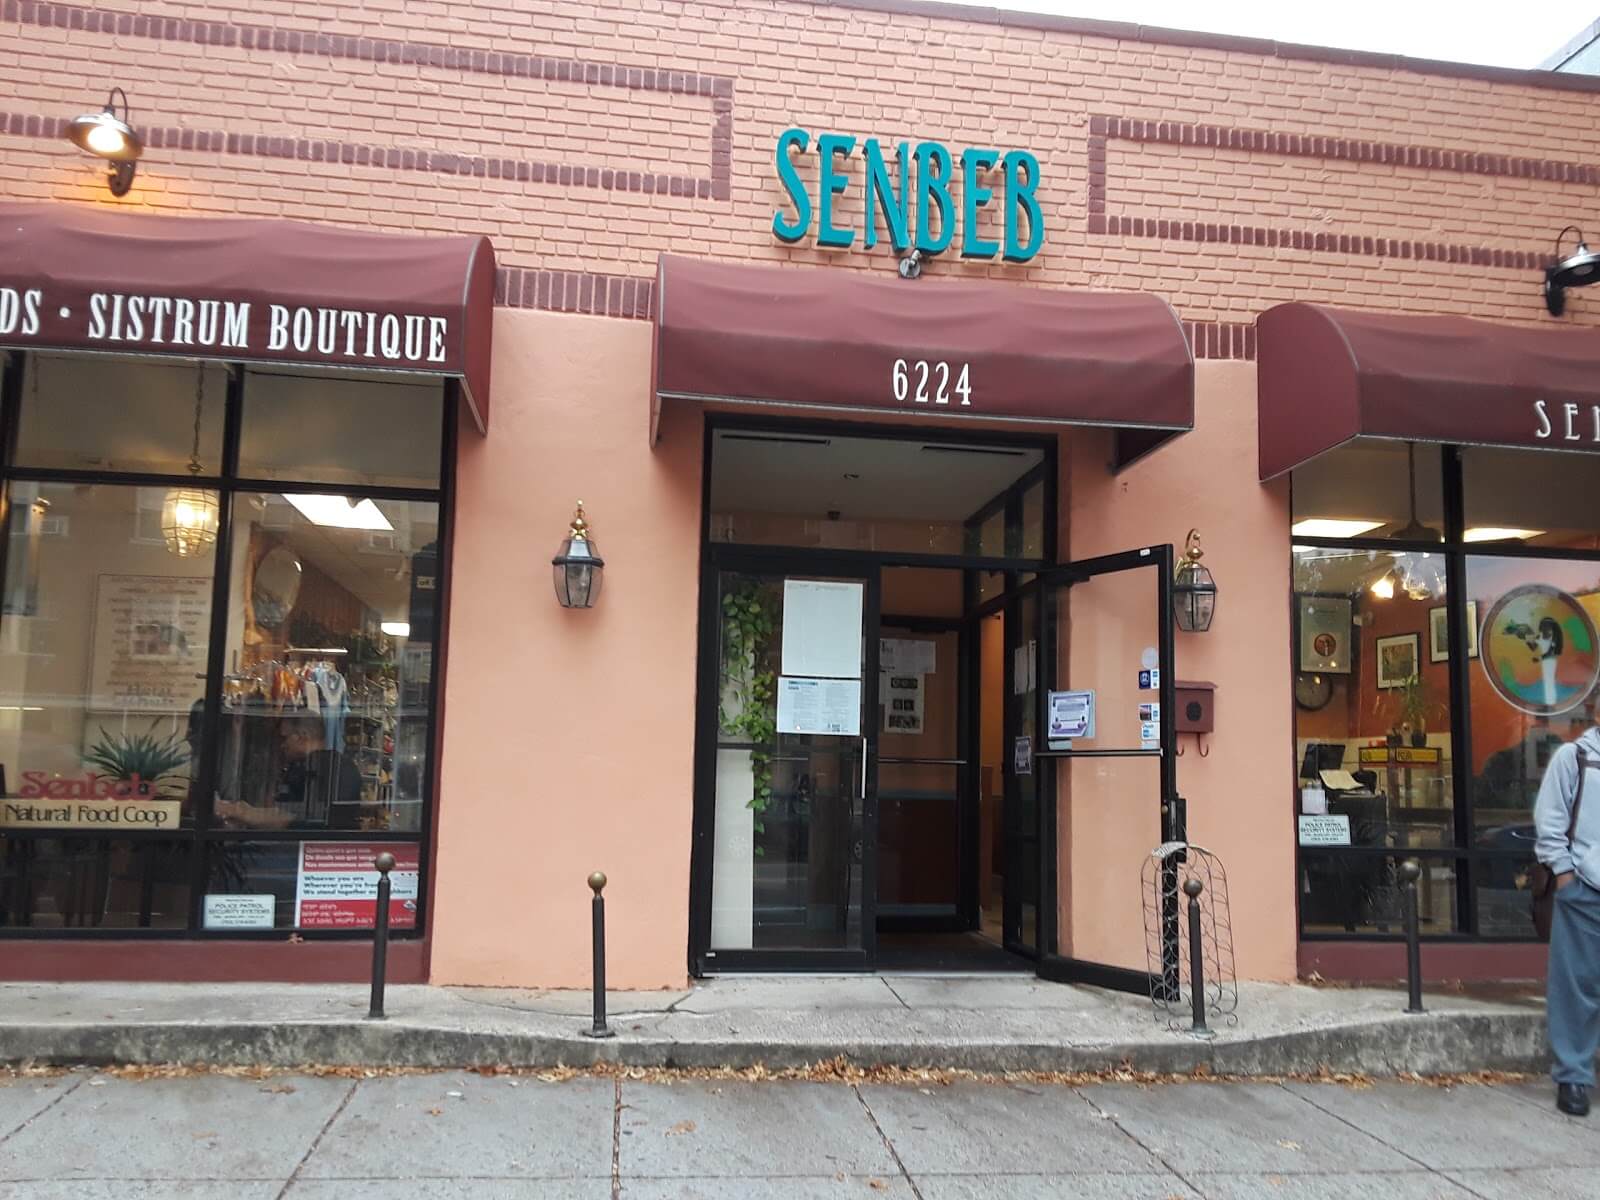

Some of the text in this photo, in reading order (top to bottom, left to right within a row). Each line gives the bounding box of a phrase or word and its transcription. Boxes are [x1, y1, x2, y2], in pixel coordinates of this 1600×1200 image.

[772, 128, 1044, 263] SENBEB
[88, 293, 251, 348] SISTRUM
[267, 304, 447, 362] BOUTIQUE
[893, 359, 972, 406] 6224
[5, 804, 168, 827] Natural Food Coop
